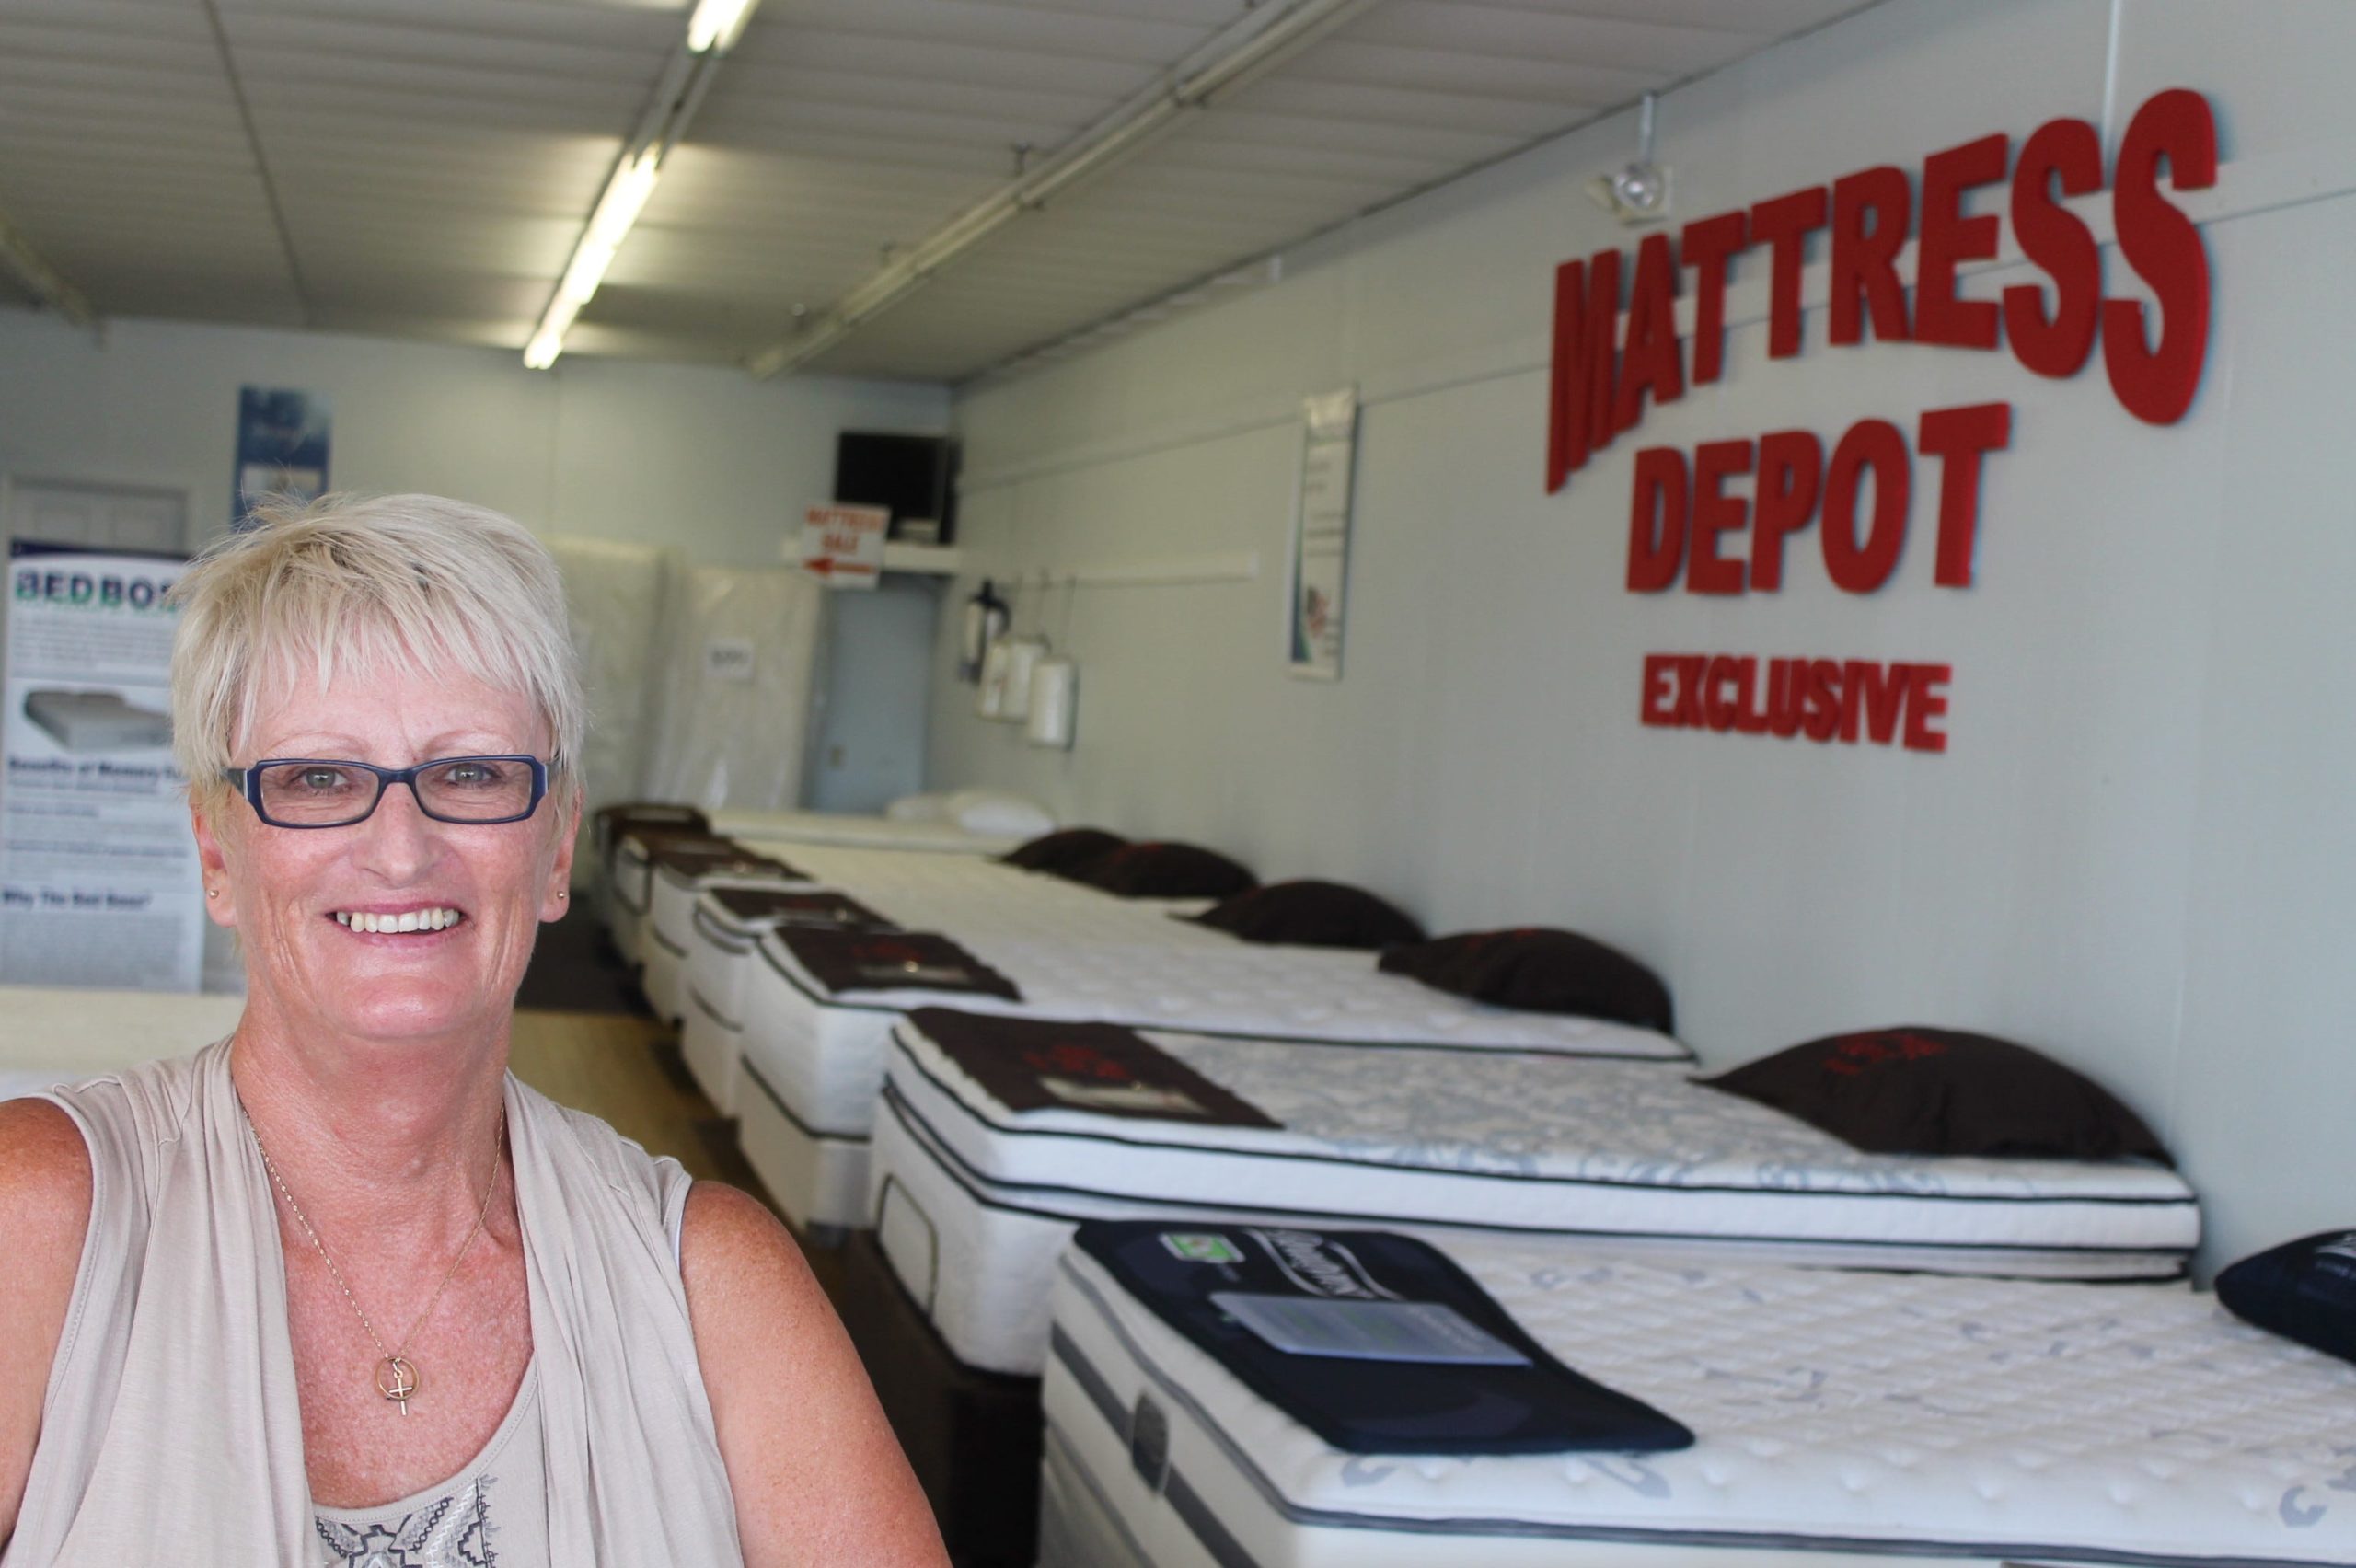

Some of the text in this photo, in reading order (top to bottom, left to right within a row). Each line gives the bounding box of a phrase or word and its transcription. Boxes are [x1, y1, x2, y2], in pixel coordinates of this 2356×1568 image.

[1547, 88, 2218, 495] MATTRESS
[1626, 402, 2011, 594] DEPOT
[1641, 654, 1952, 753] EXCLUSIVE
